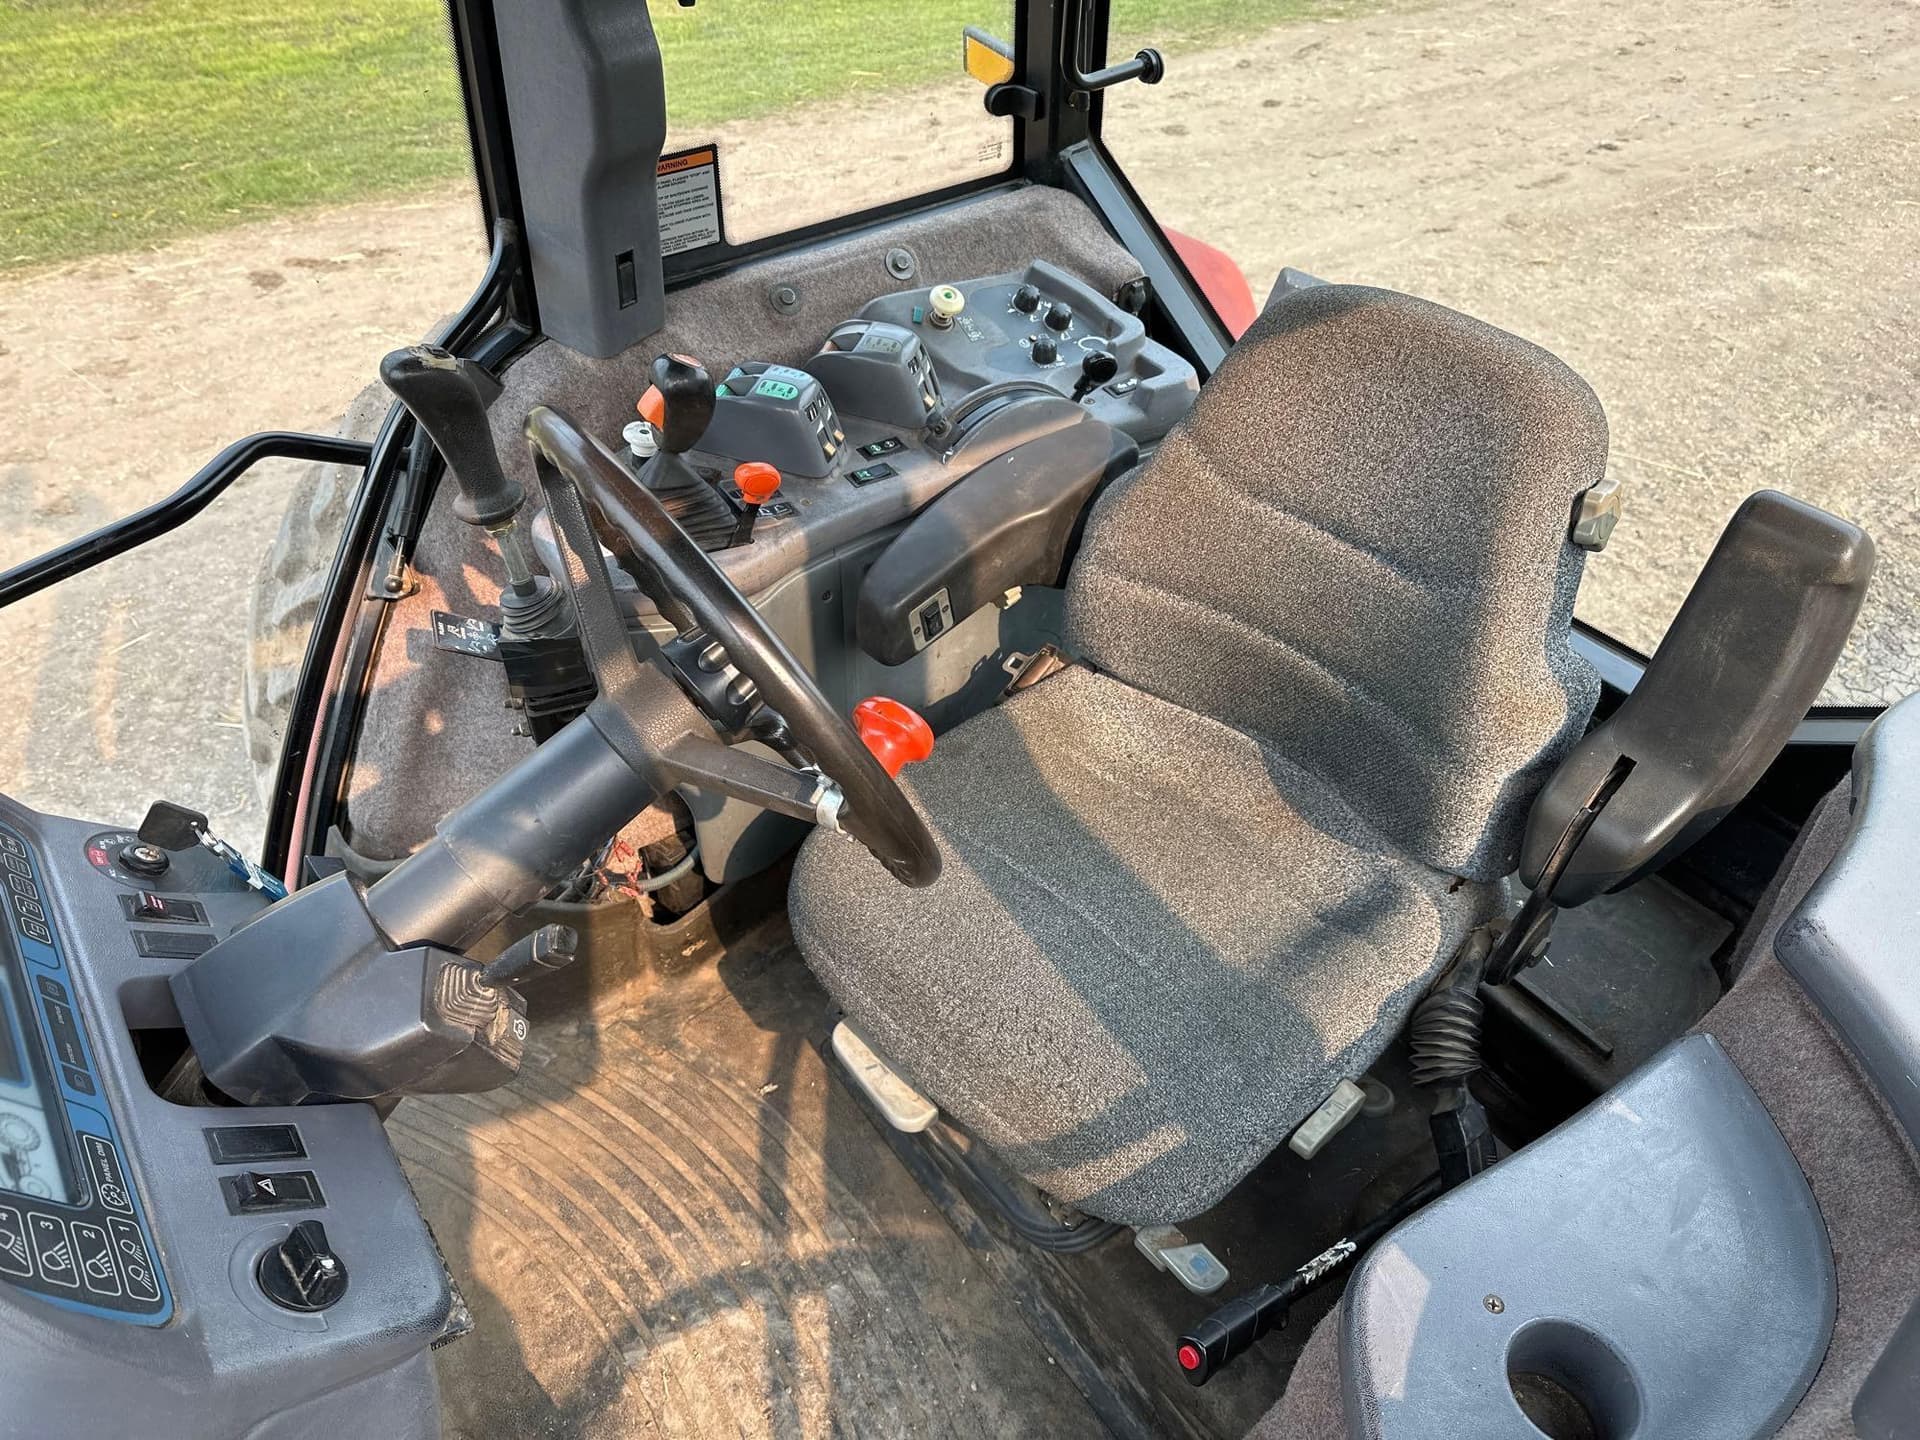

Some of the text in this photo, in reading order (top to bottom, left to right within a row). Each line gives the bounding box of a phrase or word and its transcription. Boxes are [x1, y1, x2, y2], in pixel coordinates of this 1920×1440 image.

[101, 1158, 114, 1182] PANEL
[40, 1220, 54, 1230] 3
[82, 1229, 96, 1239] 2
